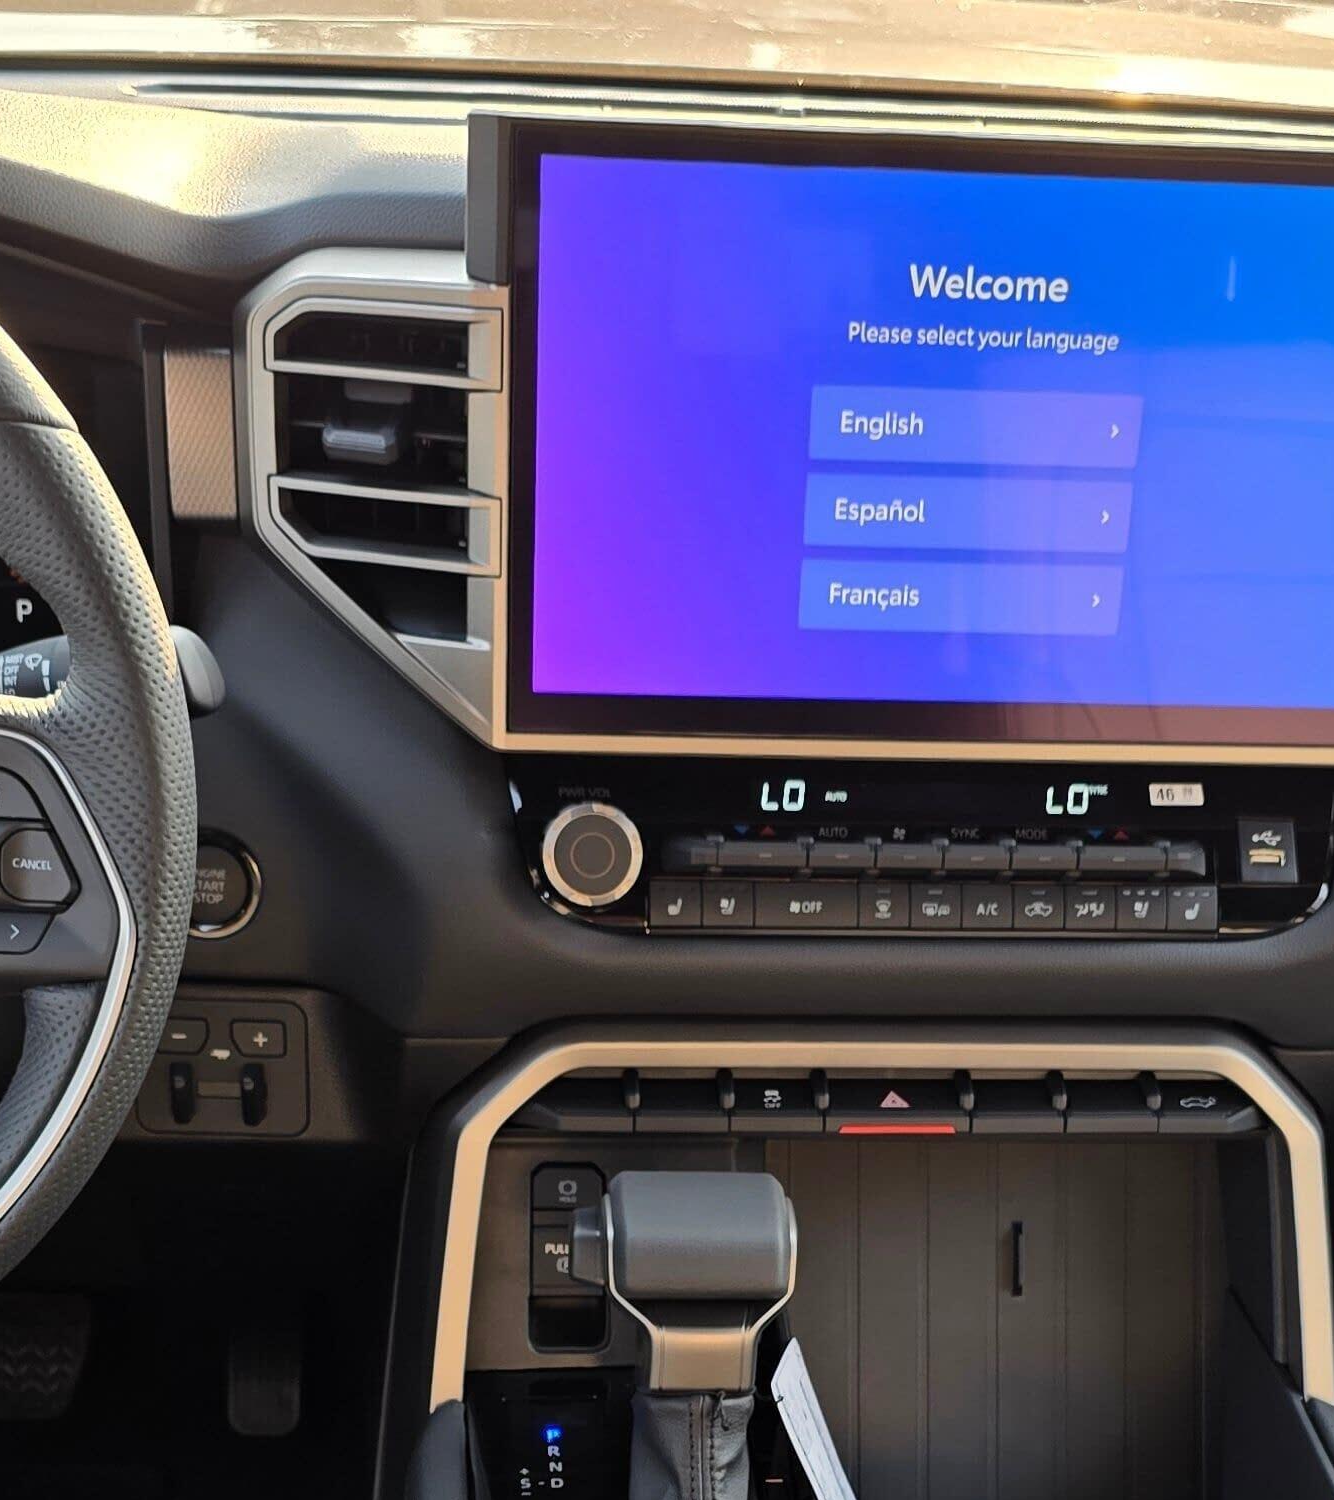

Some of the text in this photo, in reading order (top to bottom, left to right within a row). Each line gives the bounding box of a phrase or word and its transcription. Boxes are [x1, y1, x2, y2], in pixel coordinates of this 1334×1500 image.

[909, 263, 1069, 303] Welcome
[848, 320, 1120, 356] Please select your language
[840, 409, 924, 441] English
[835, 496, 926, 527] Español
[16, 597, 33, 623] P
[829, 582, 920, 612] Français
[761, 779, 806, 812] LO
[1046, 783, 1089, 815] LO
[818, 827, 1048, 840] AUTO SYNC MODE
[12, 857, 52, 871] CANCEL
[802, 901, 999, 916] OFF A/C
[547, 1445, 561, 1457] R
[549, 1461, 563, 1472] N
[520, 1477, 564, 1489] S D
